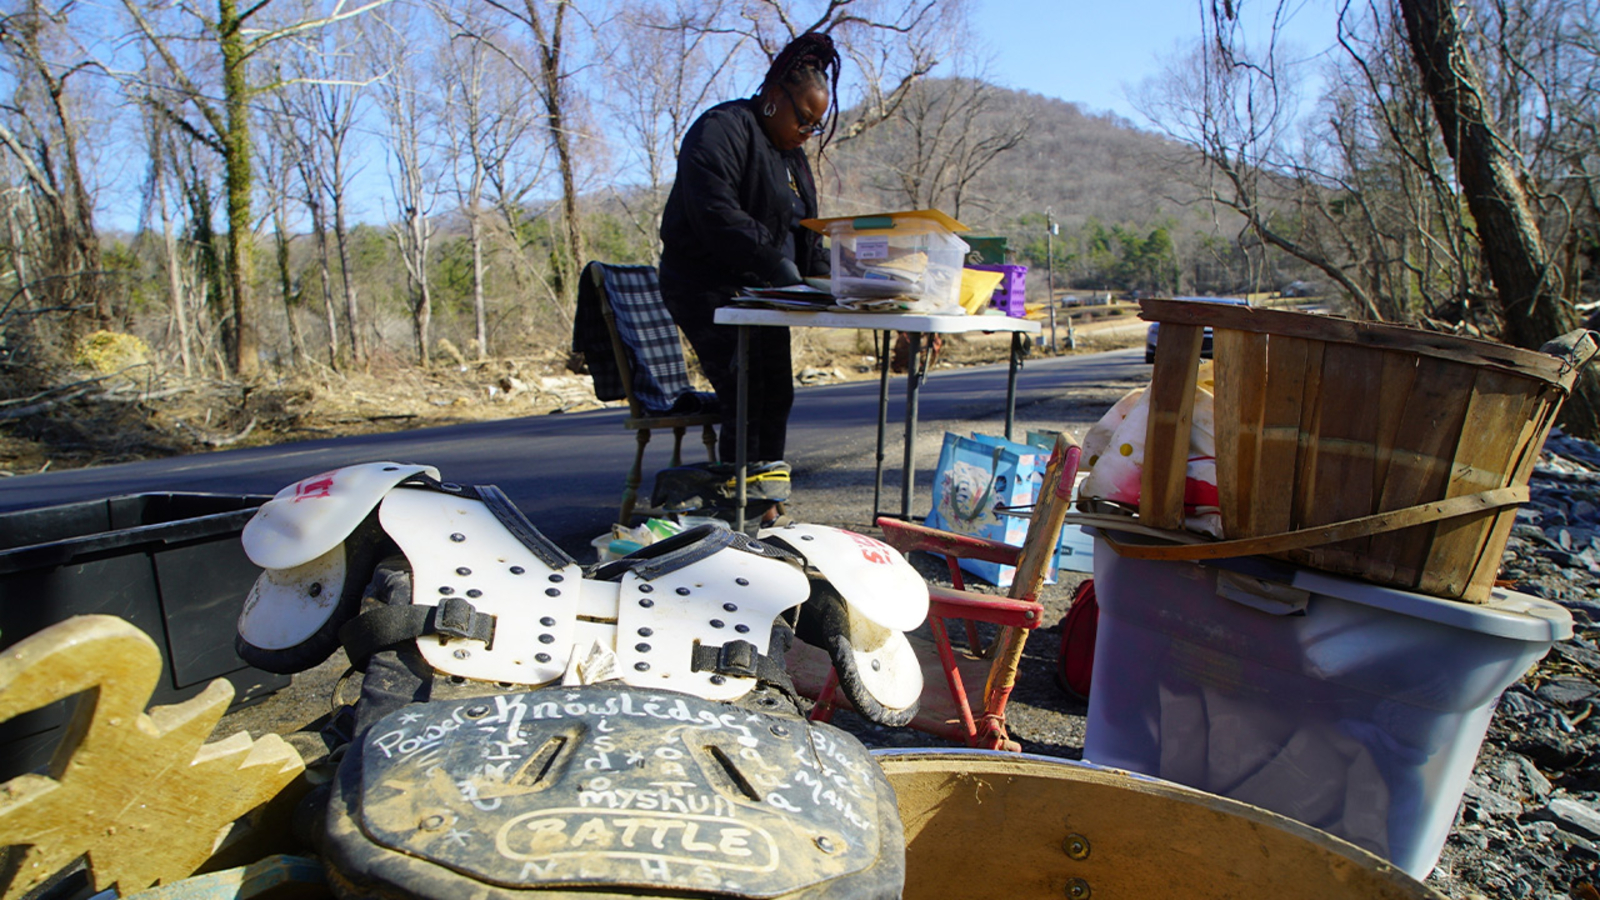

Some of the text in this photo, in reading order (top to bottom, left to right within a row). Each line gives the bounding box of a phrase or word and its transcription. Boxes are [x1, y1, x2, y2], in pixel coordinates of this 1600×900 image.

[371, 705, 464, 758] Power
[793, 746, 862, 799] Lives
[810, 730, 870, 787] Black
[527, 817, 752, 857] BATTLE
